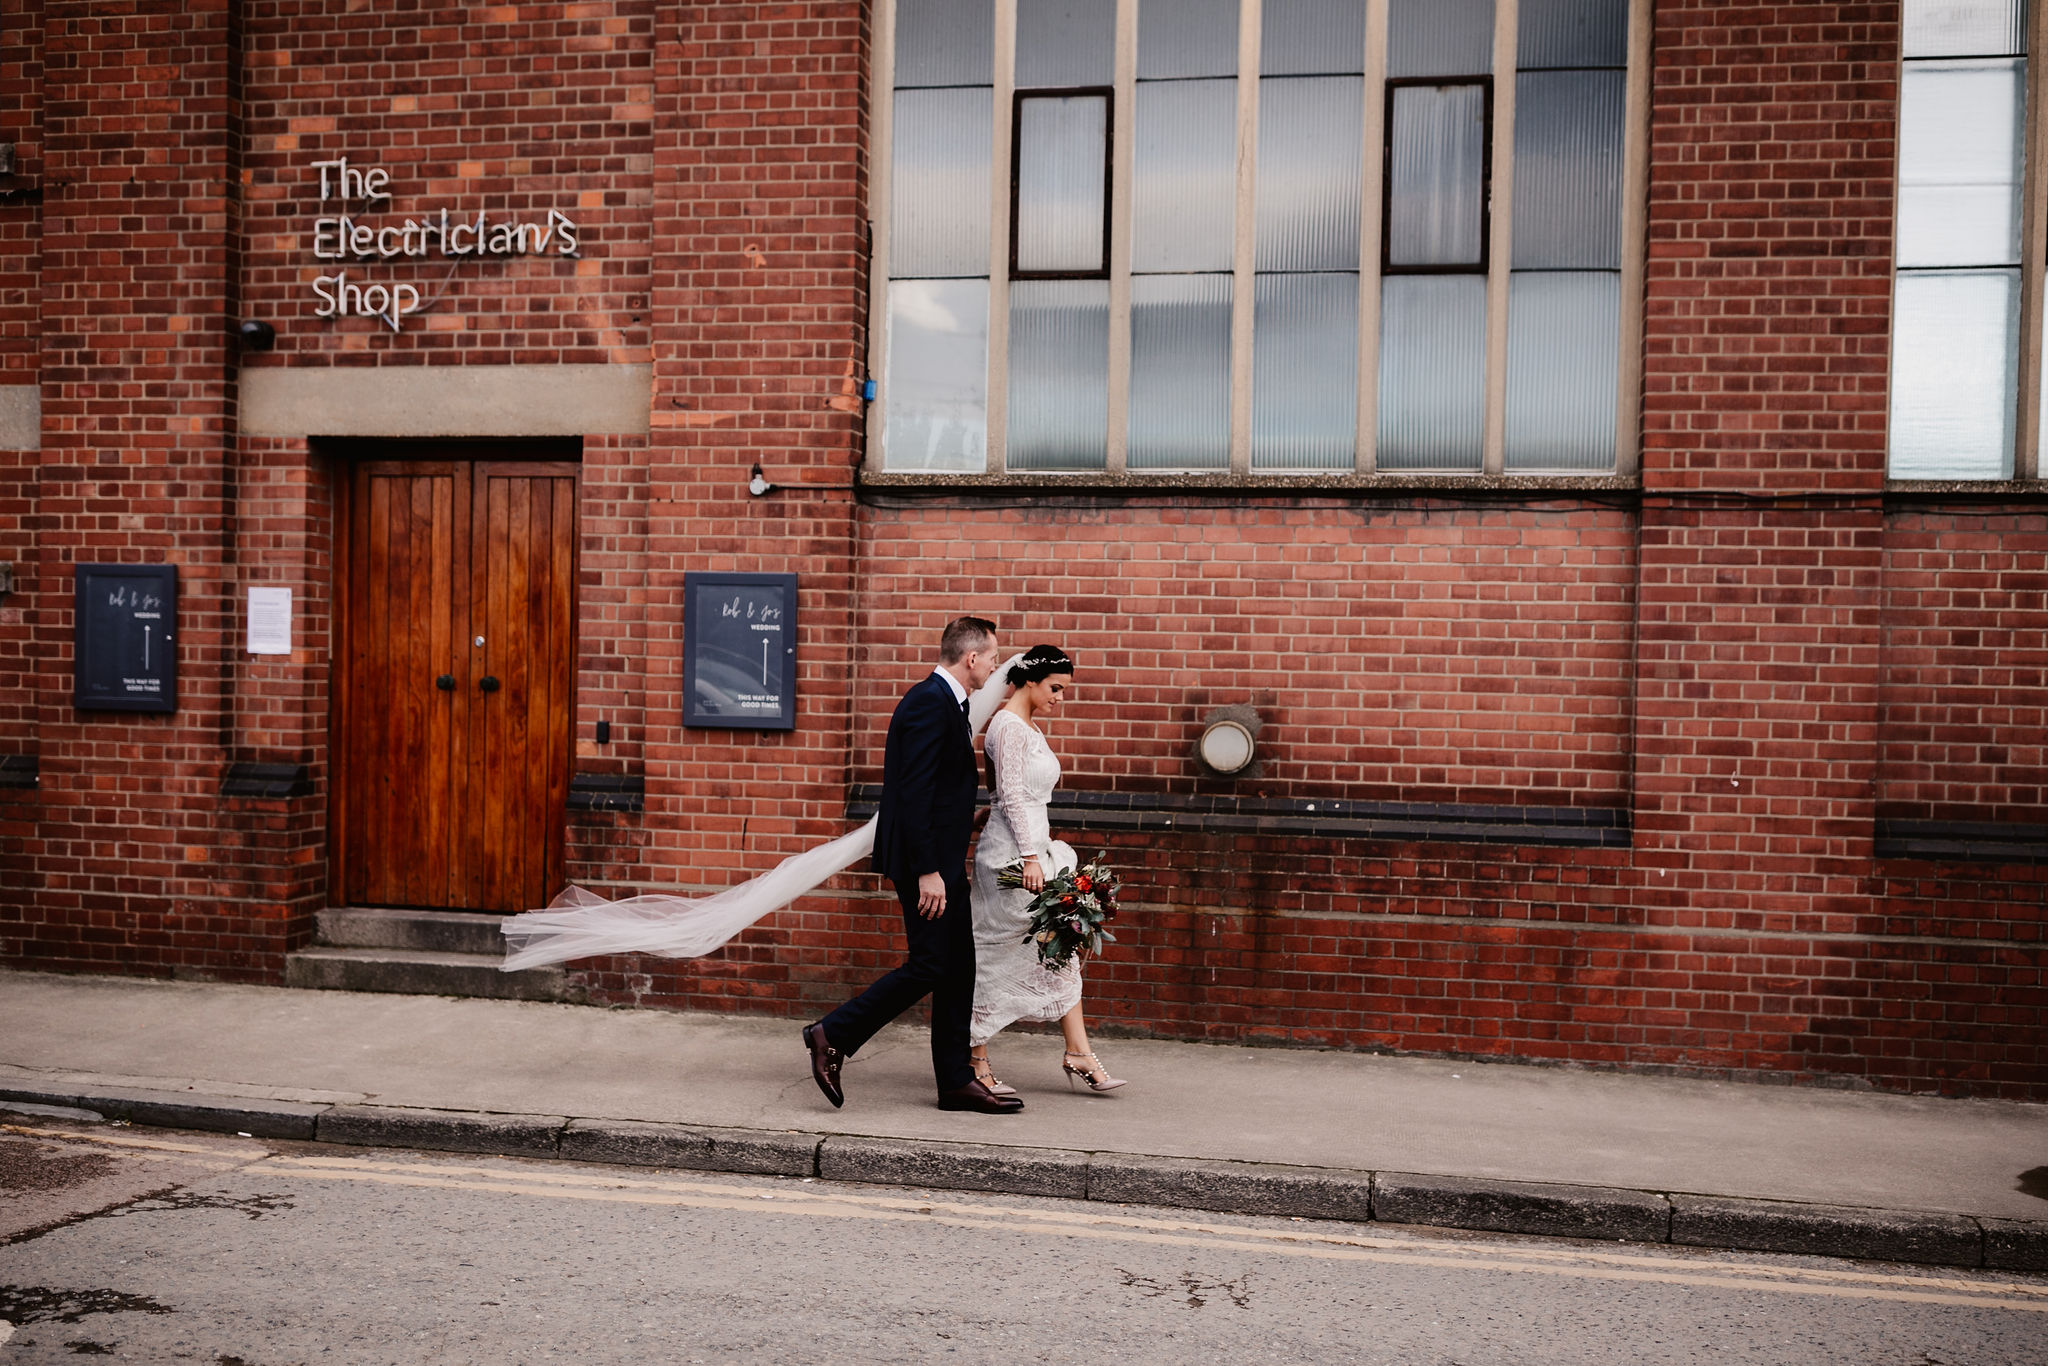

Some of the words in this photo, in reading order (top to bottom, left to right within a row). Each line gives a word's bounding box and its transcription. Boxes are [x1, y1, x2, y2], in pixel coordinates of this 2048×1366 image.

[310, 156, 392, 201] The
[313, 207, 580, 259] Electrician's
[312, 272, 420, 333] Shop
